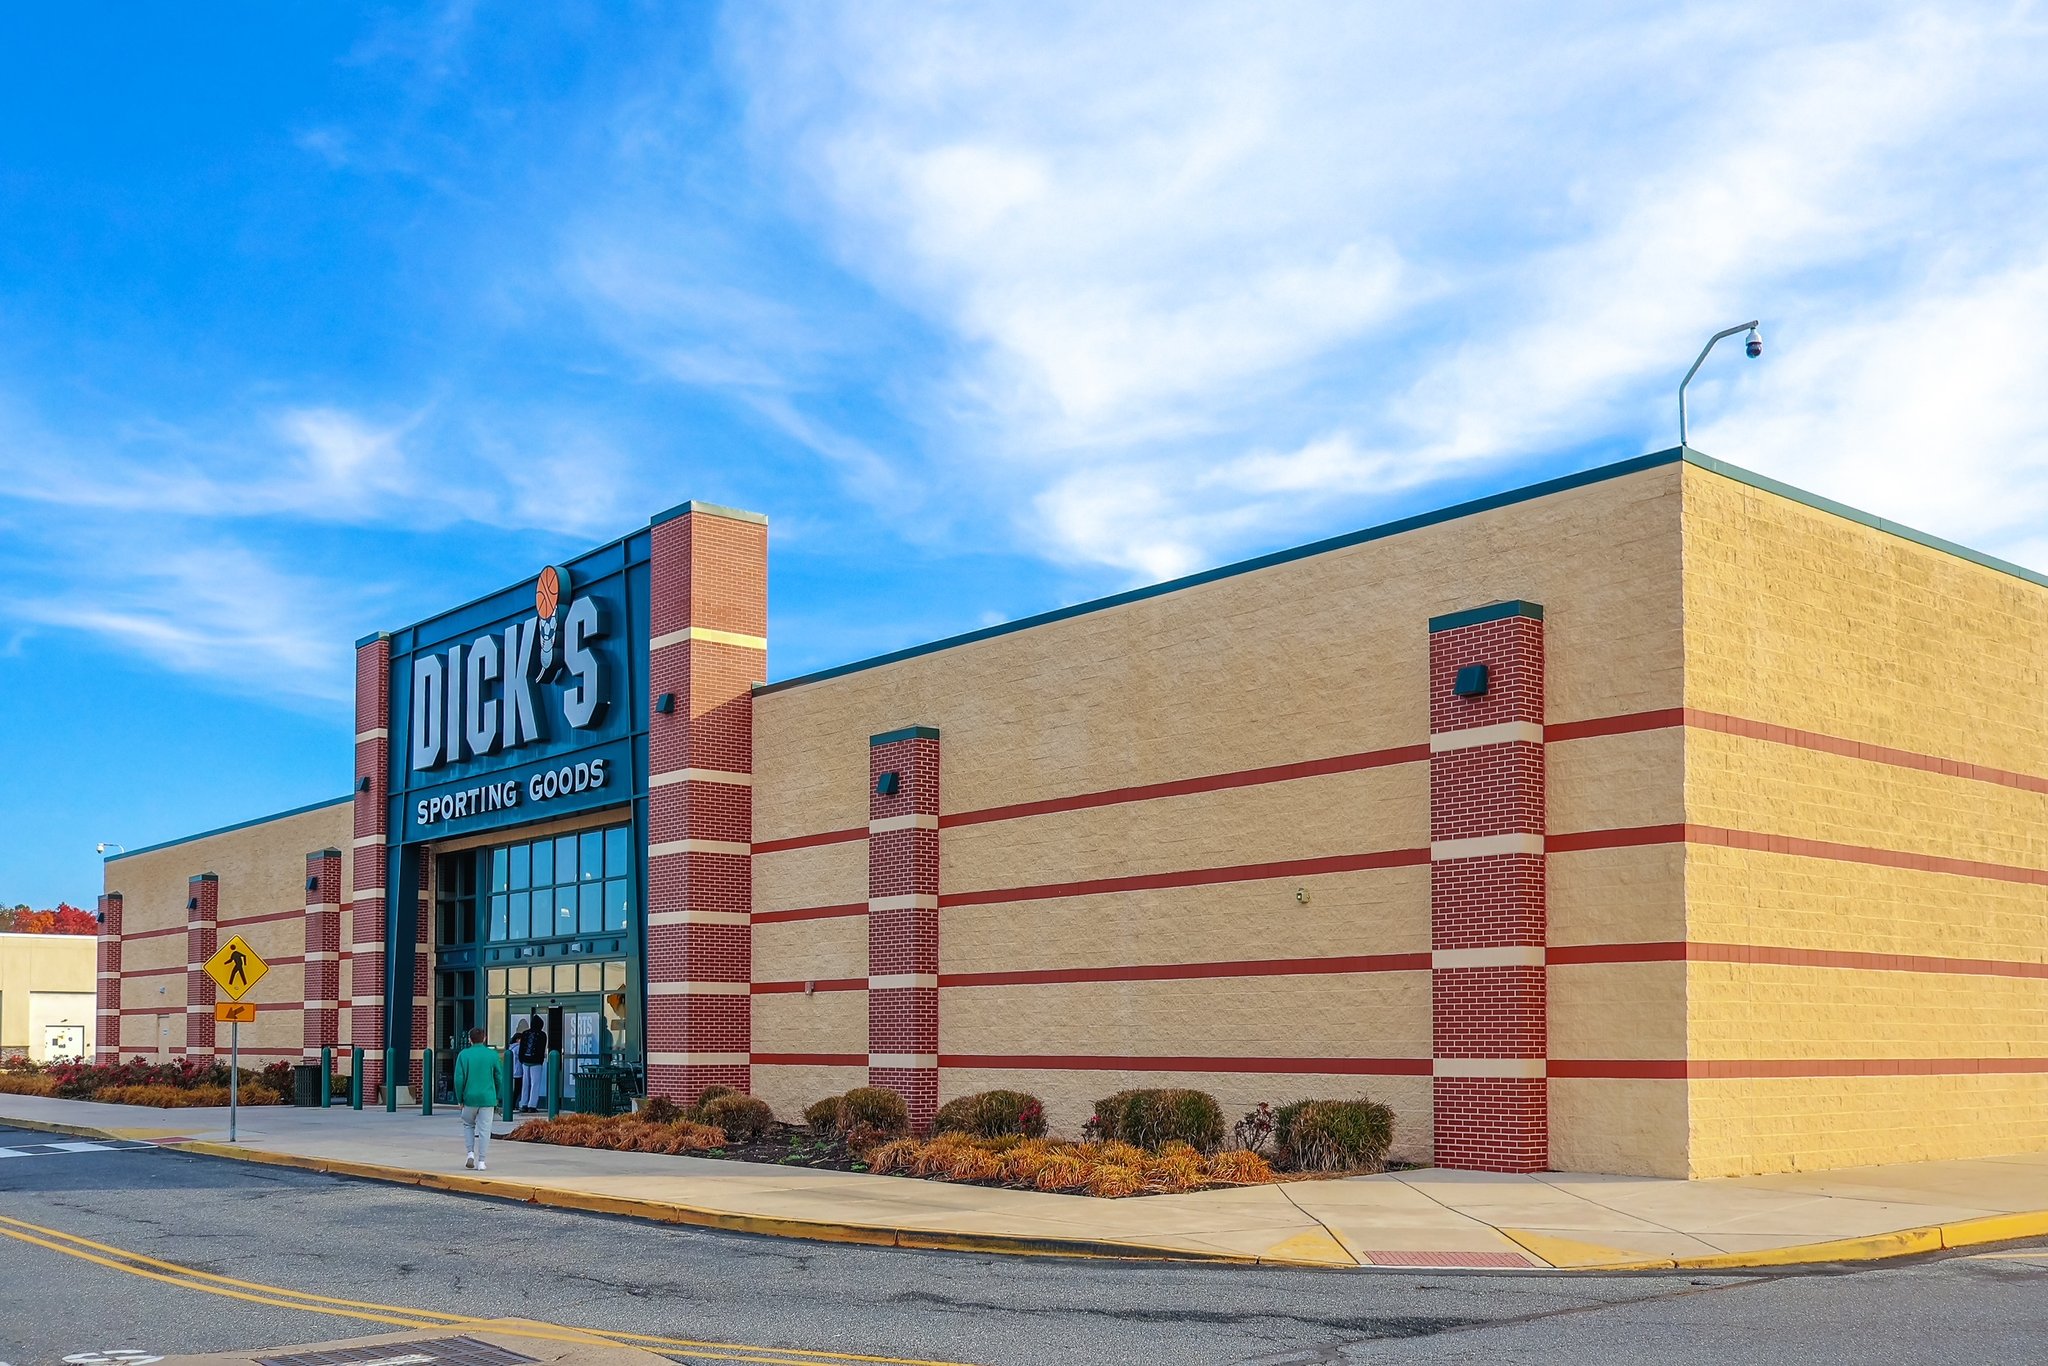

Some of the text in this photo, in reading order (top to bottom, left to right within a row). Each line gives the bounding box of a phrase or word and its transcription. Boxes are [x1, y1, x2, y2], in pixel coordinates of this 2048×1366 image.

[413, 595, 600, 771] DICK'S
[417, 759, 606, 825] SPORTING GOODS
